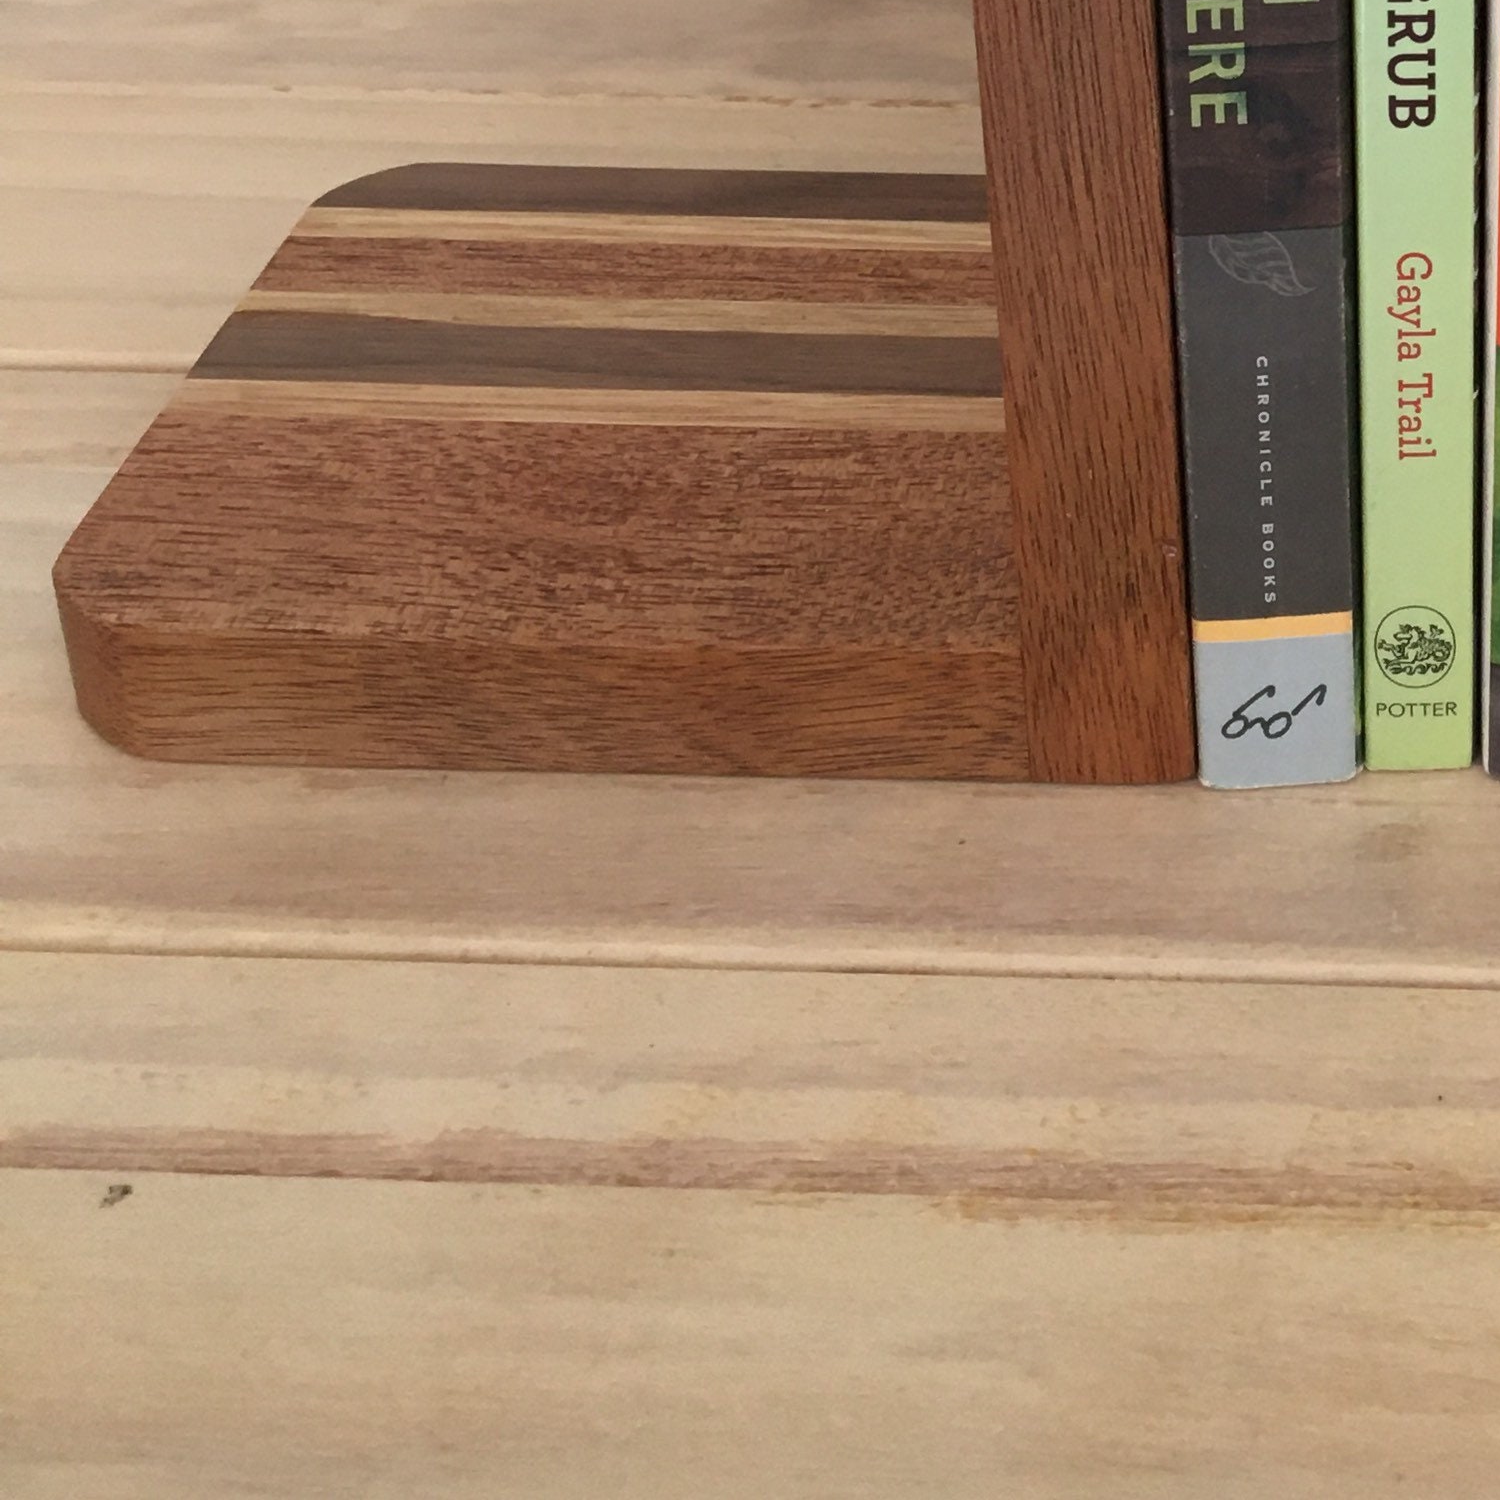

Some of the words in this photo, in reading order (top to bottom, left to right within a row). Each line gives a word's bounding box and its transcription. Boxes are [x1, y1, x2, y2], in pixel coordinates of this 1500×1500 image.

[1387, 252, 1437, 361] Gayla
[1256, 356, 1273, 506] CHRONICLE
[1397, 373, 1437, 460] Trail
[1262, 523, 1277, 603] BOOKS
[1376, 702, 1458, 718] POTTER
